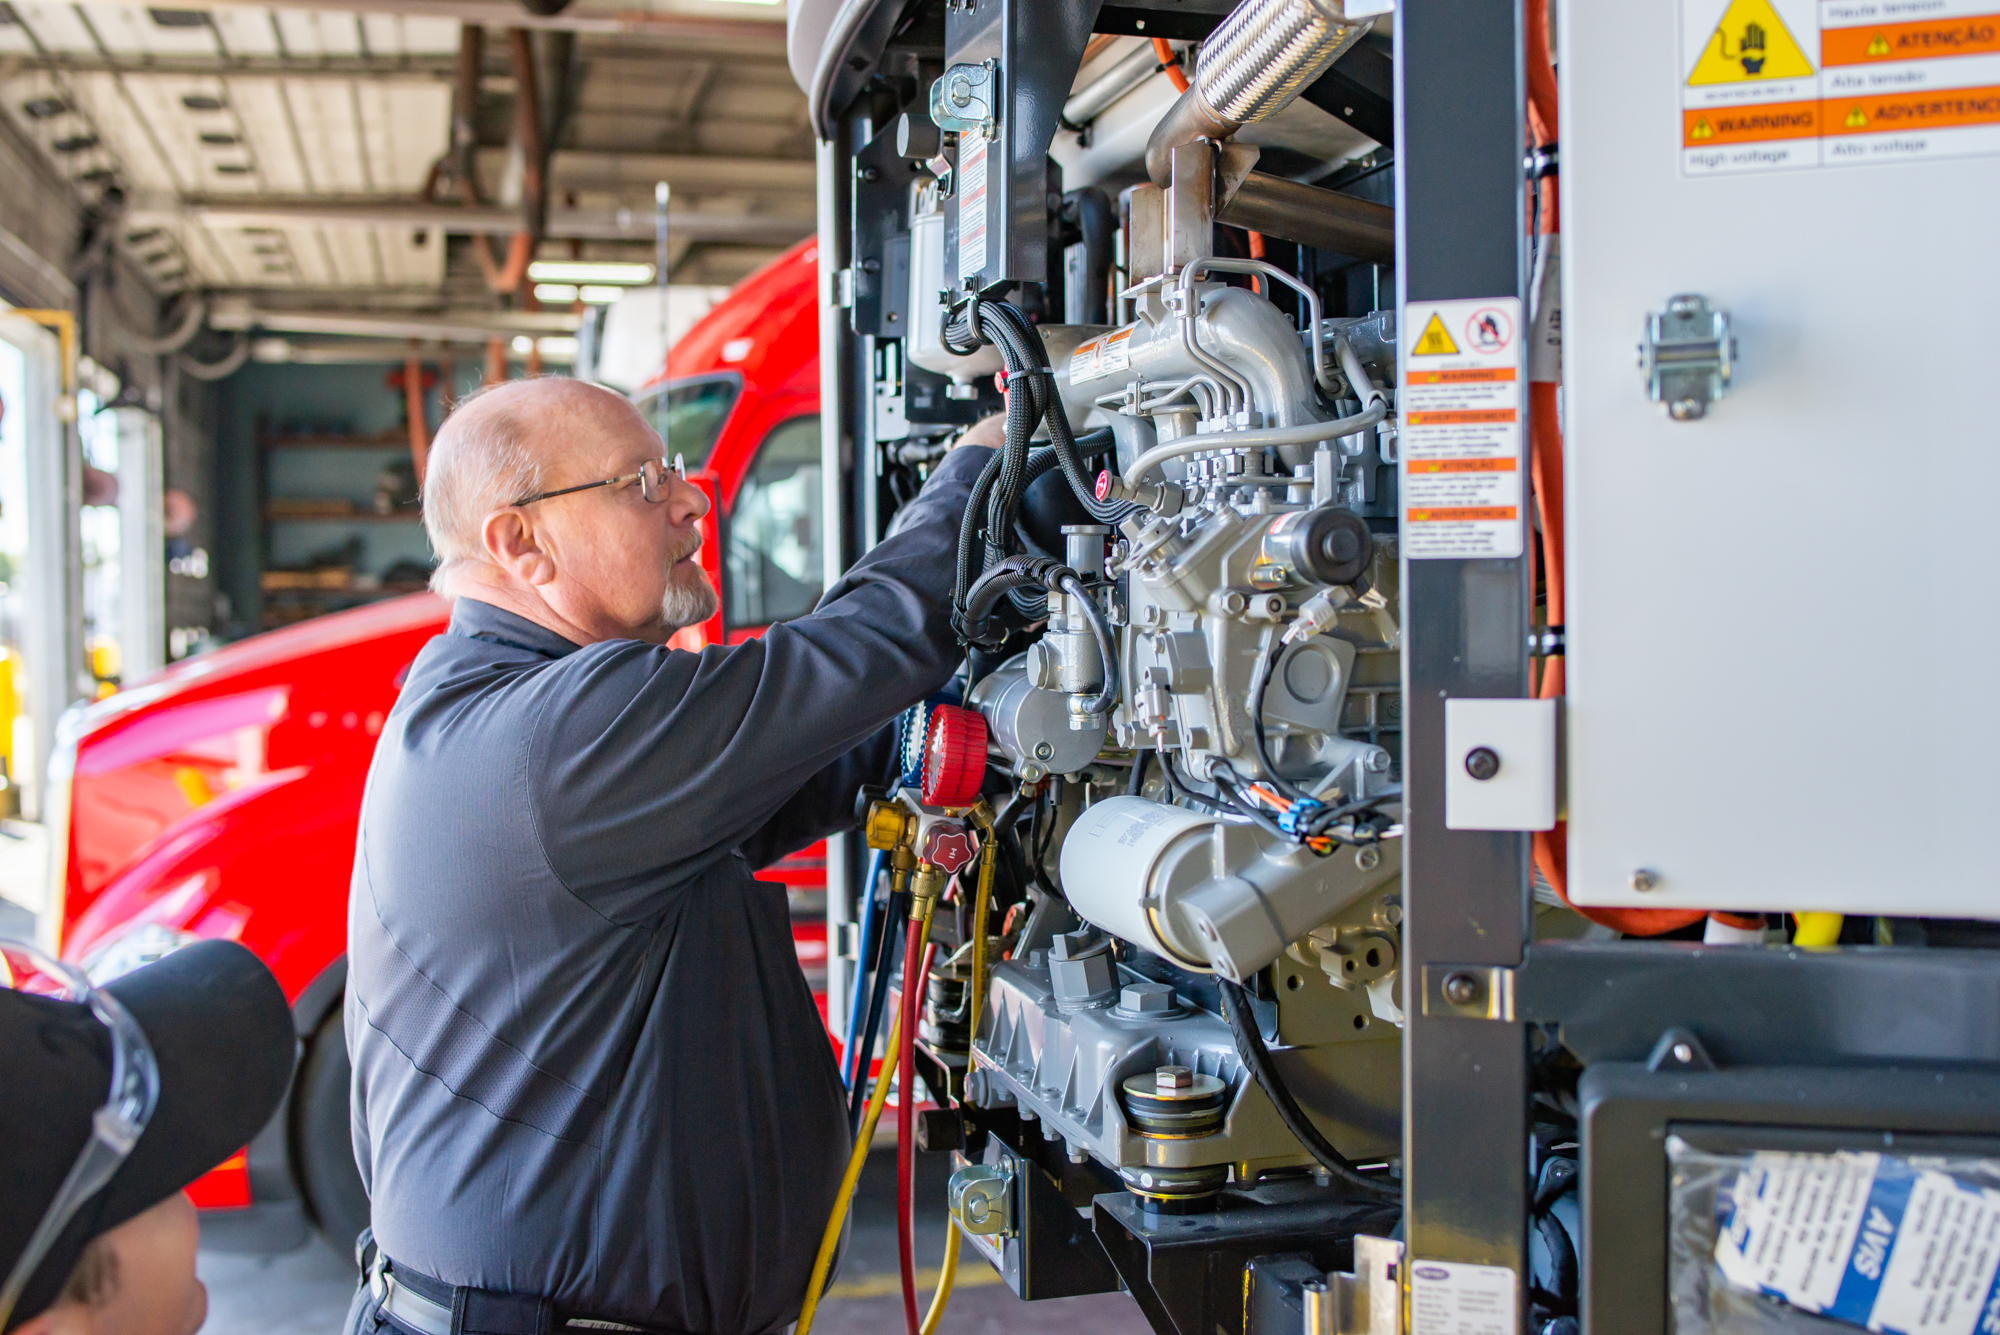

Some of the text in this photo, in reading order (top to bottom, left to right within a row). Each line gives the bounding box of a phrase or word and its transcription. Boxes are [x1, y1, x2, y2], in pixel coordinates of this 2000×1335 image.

[1898, 25, 1995, 48] ATENÇÃO
[1716, 111, 1813, 133] WARNING
[1690, 147, 1789, 170] High voltage
[1853, 1206, 1894, 1281] AVIS
